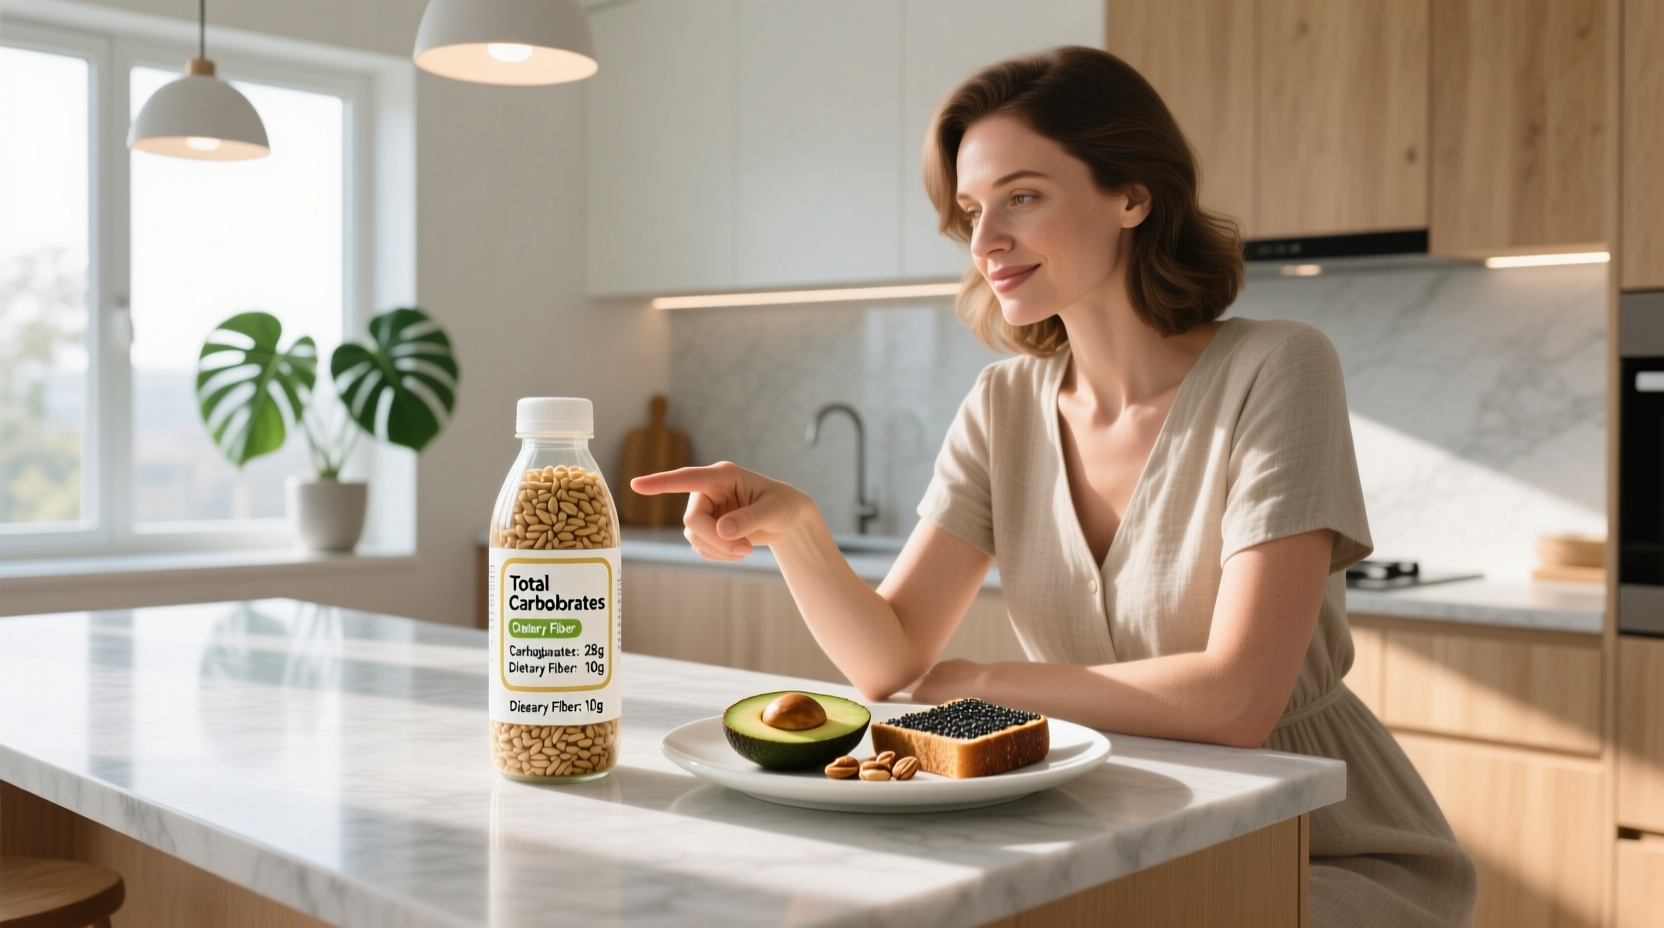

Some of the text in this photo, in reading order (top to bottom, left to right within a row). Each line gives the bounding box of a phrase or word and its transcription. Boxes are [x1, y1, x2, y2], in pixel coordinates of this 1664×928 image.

[509, 574, 549, 592] Total
[584, 643, 605, 659] 28g
[509, 661, 546, 677] Dietary
[585, 660, 605, 676] 10g
[585, 698, 604, 714] 10g
